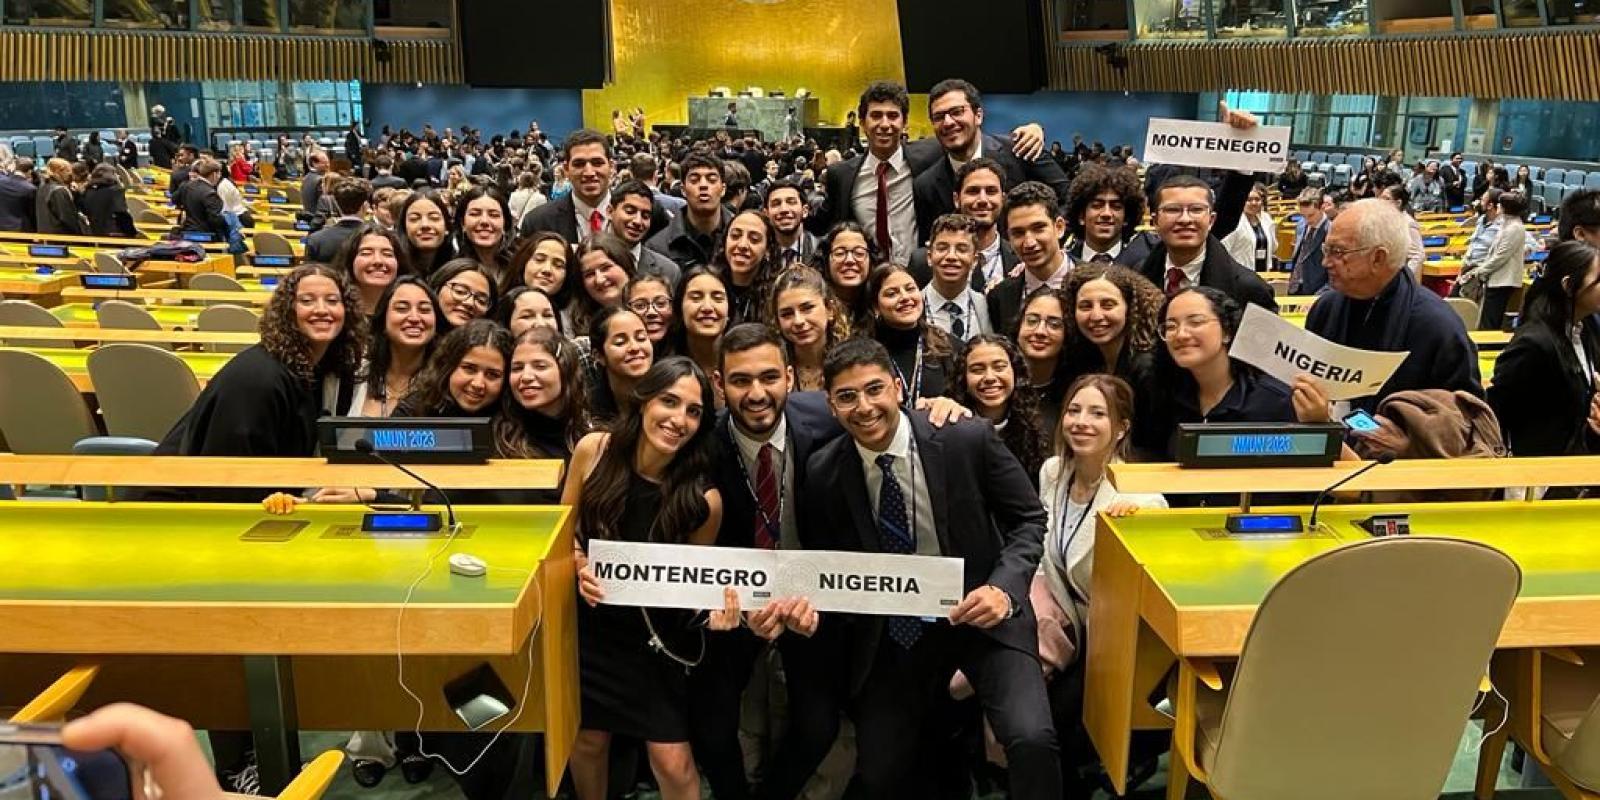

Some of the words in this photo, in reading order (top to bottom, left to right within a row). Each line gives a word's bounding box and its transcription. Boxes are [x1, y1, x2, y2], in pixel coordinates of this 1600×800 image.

[1152, 134, 1282, 154] MONTENEGRO
[1274, 341, 1363, 384] NIGERIA
[373, 429, 406, 448] NMUN
[409, 430, 435, 448] 2023
[1266, 435, 1292, 453] 2023
[594, 561, 768, 587] MONTENEGRO
[819, 573, 920, 594] NIGERIA
